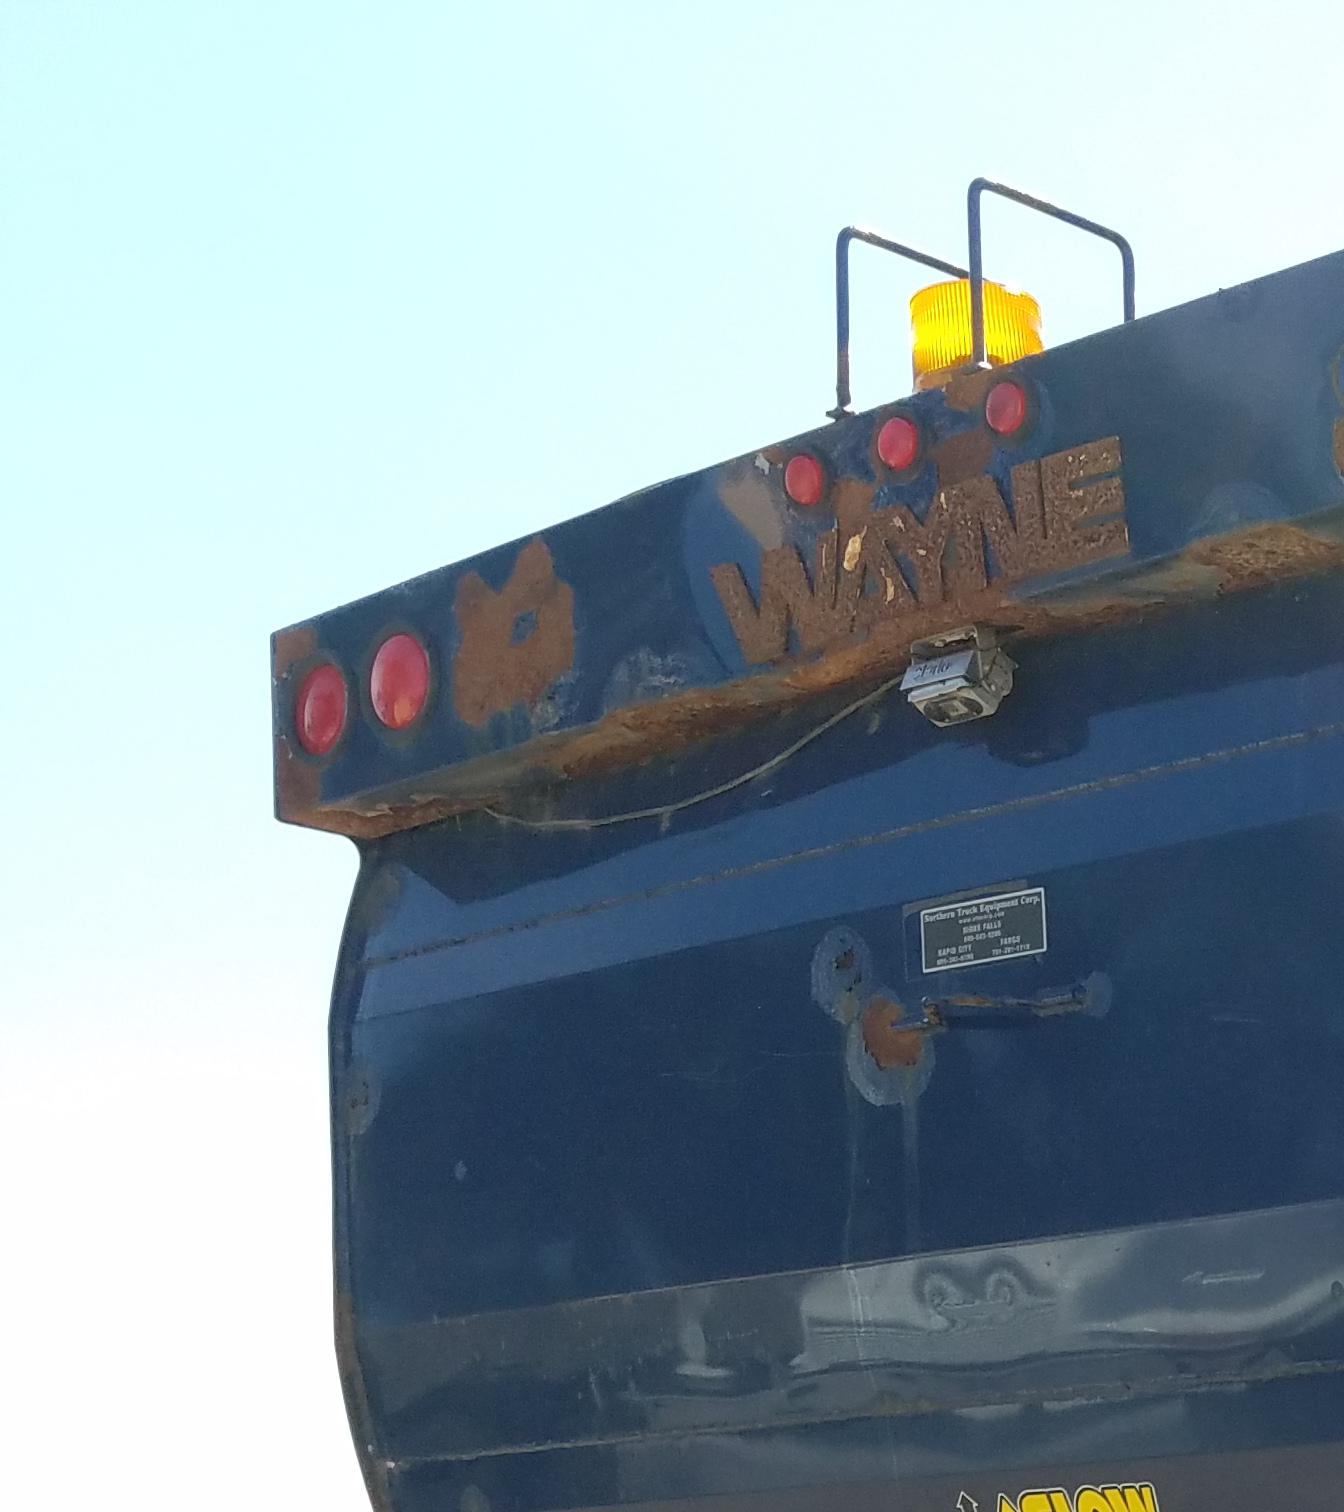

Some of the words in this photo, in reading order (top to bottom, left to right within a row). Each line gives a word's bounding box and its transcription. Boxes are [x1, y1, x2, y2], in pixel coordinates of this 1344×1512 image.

[709, 435, 1130, 664] WAYNE
[957, 907, 978, 918] Truck
[980, 900, 1019, 914] Equipment
[1020, 895, 1041, 907] Corp.
